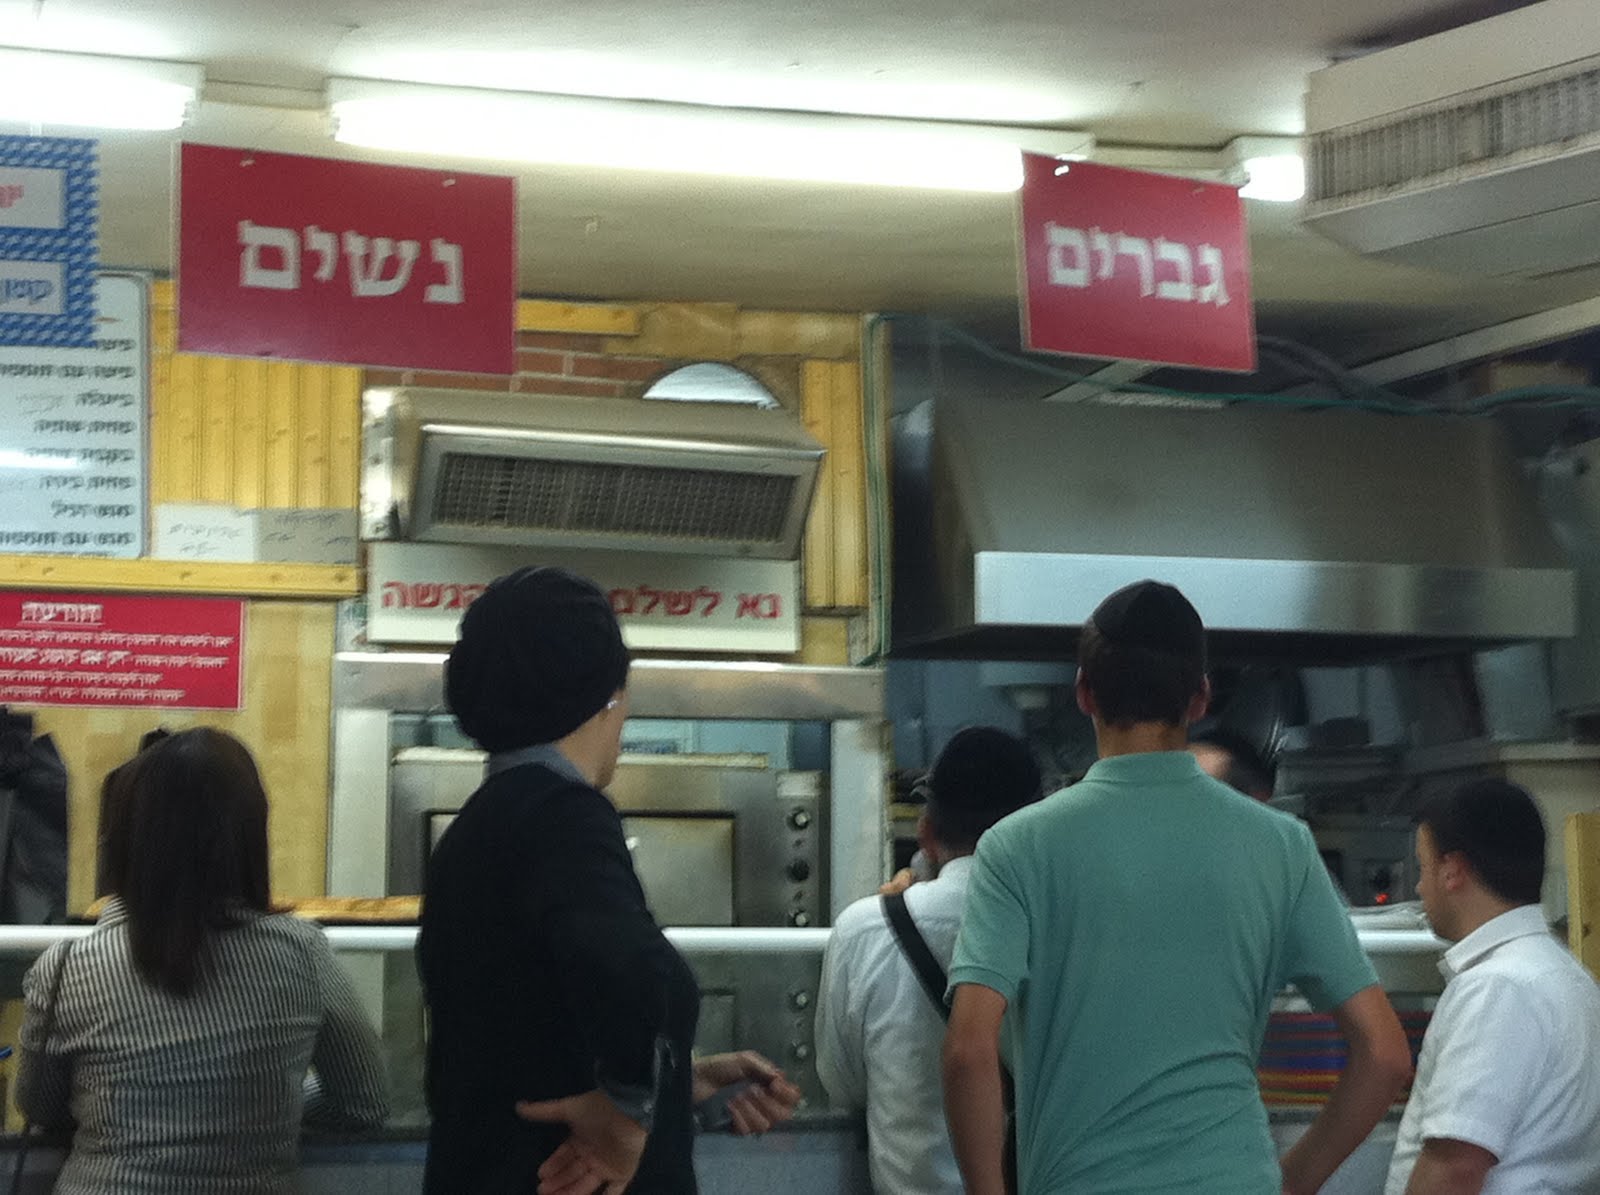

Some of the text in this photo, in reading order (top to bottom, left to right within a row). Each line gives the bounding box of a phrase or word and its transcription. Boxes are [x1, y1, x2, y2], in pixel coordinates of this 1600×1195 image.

[238, 219, 466, 306] נשים
[1045, 221, 1231, 308] גברים
[0, 363, 54, 377] תוספו
[607, 583, 723, 617] לשלם
[735, 592, 782, 620] נא
